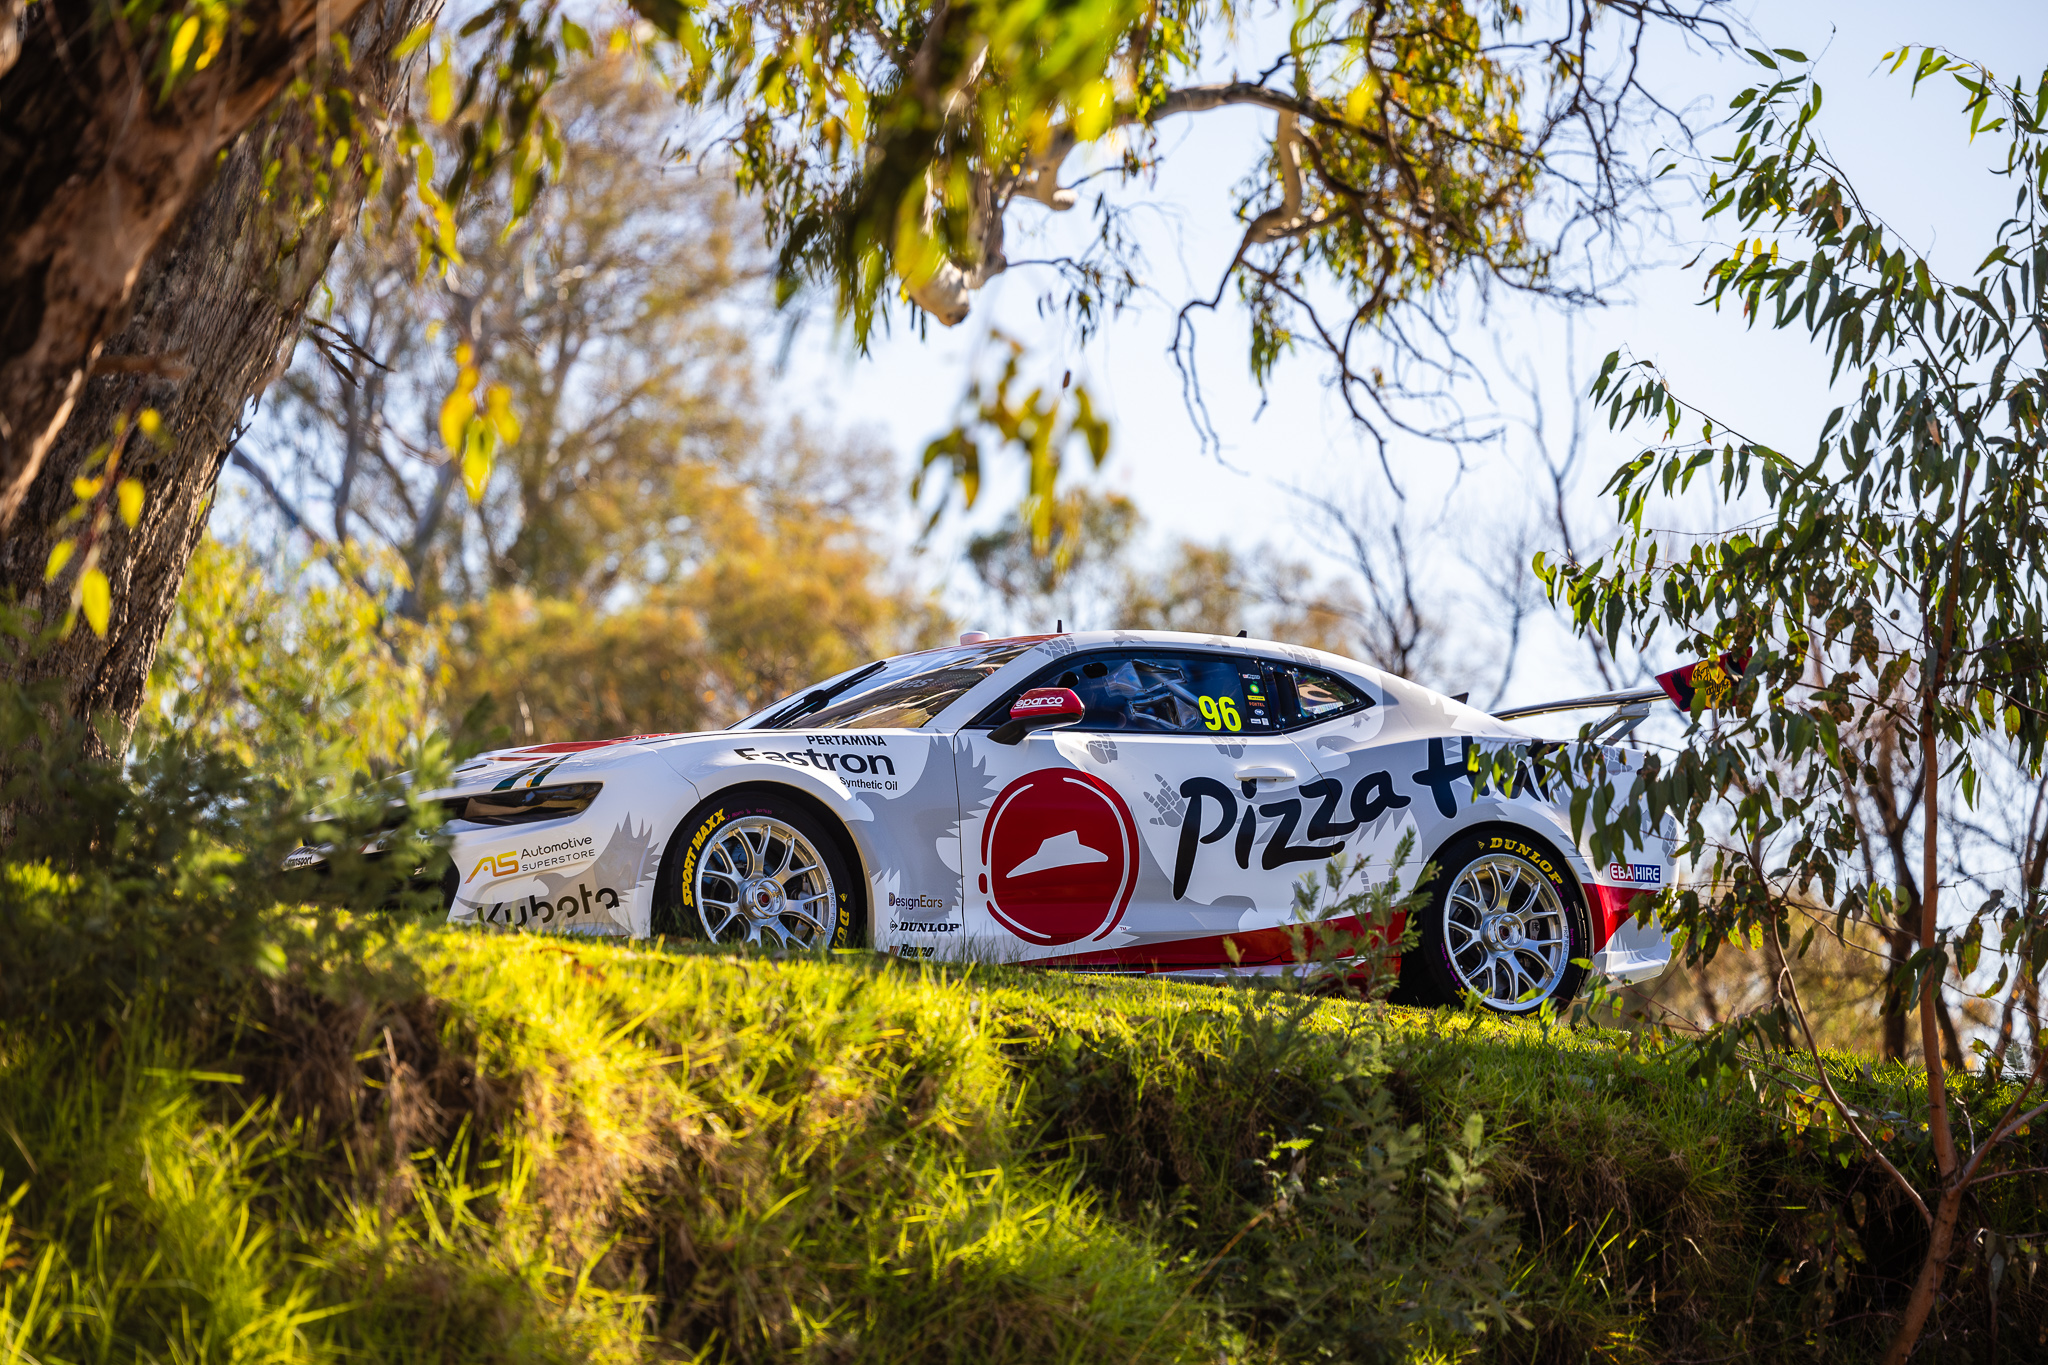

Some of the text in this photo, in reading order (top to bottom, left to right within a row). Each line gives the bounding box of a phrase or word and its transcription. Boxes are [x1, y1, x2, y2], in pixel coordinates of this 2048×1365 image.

[1015, 696, 1064, 709] sparco
[1198, 695, 1242, 732] 96
[806, 735, 888, 747] PERTAMINA
[733, 747, 896, 776] Fastron
[839, 776, 898, 791] Synthetic Oil
[1173, 769, 1412, 901] Pizza
[521, 836, 593, 860] Automotive
[521, 848, 596, 872] SUPERSTORE
[682, 808, 726, 908] SPORT MAXX
[1489, 837, 1563, 885] DUNLOP
[1611, 865, 1660, 881] EBA HIRE
[476, 883, 620, 927] Kubota
[888, 892, 943, 911] DesignEars
[899, 921, 960, 933] DUNLOP
